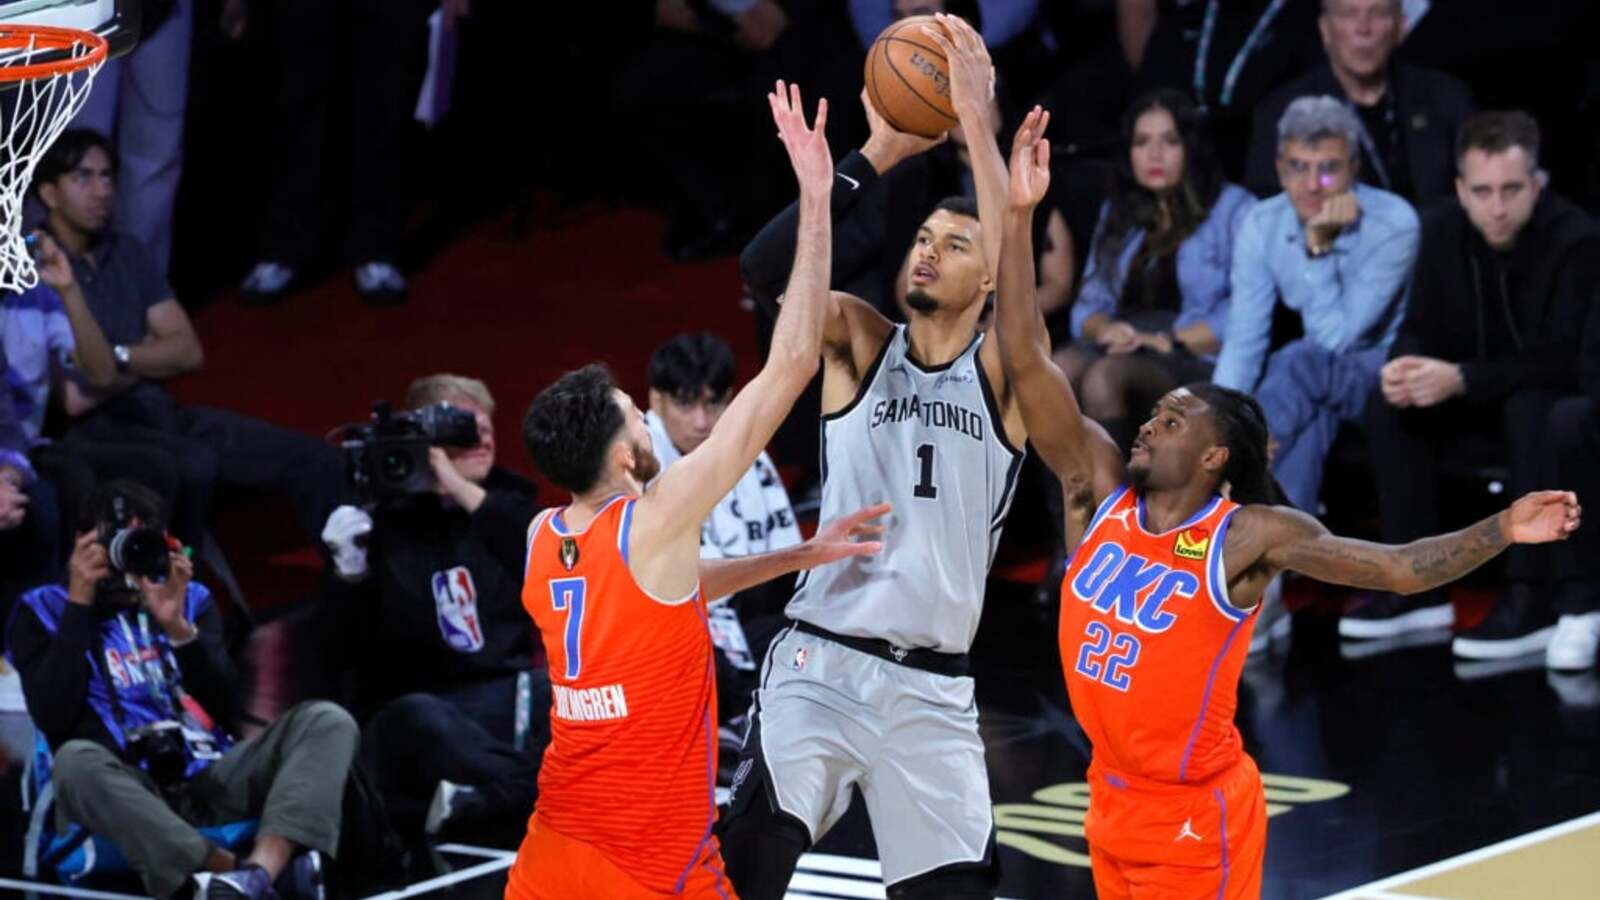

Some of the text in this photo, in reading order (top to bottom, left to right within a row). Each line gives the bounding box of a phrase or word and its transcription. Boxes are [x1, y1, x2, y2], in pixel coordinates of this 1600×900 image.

[914, 443, 938, 499] 1
[549, 576, 587, 680] 7
[1072, 541, 1200, 634] OKC
[1075, 620, 1142, 692] 22
